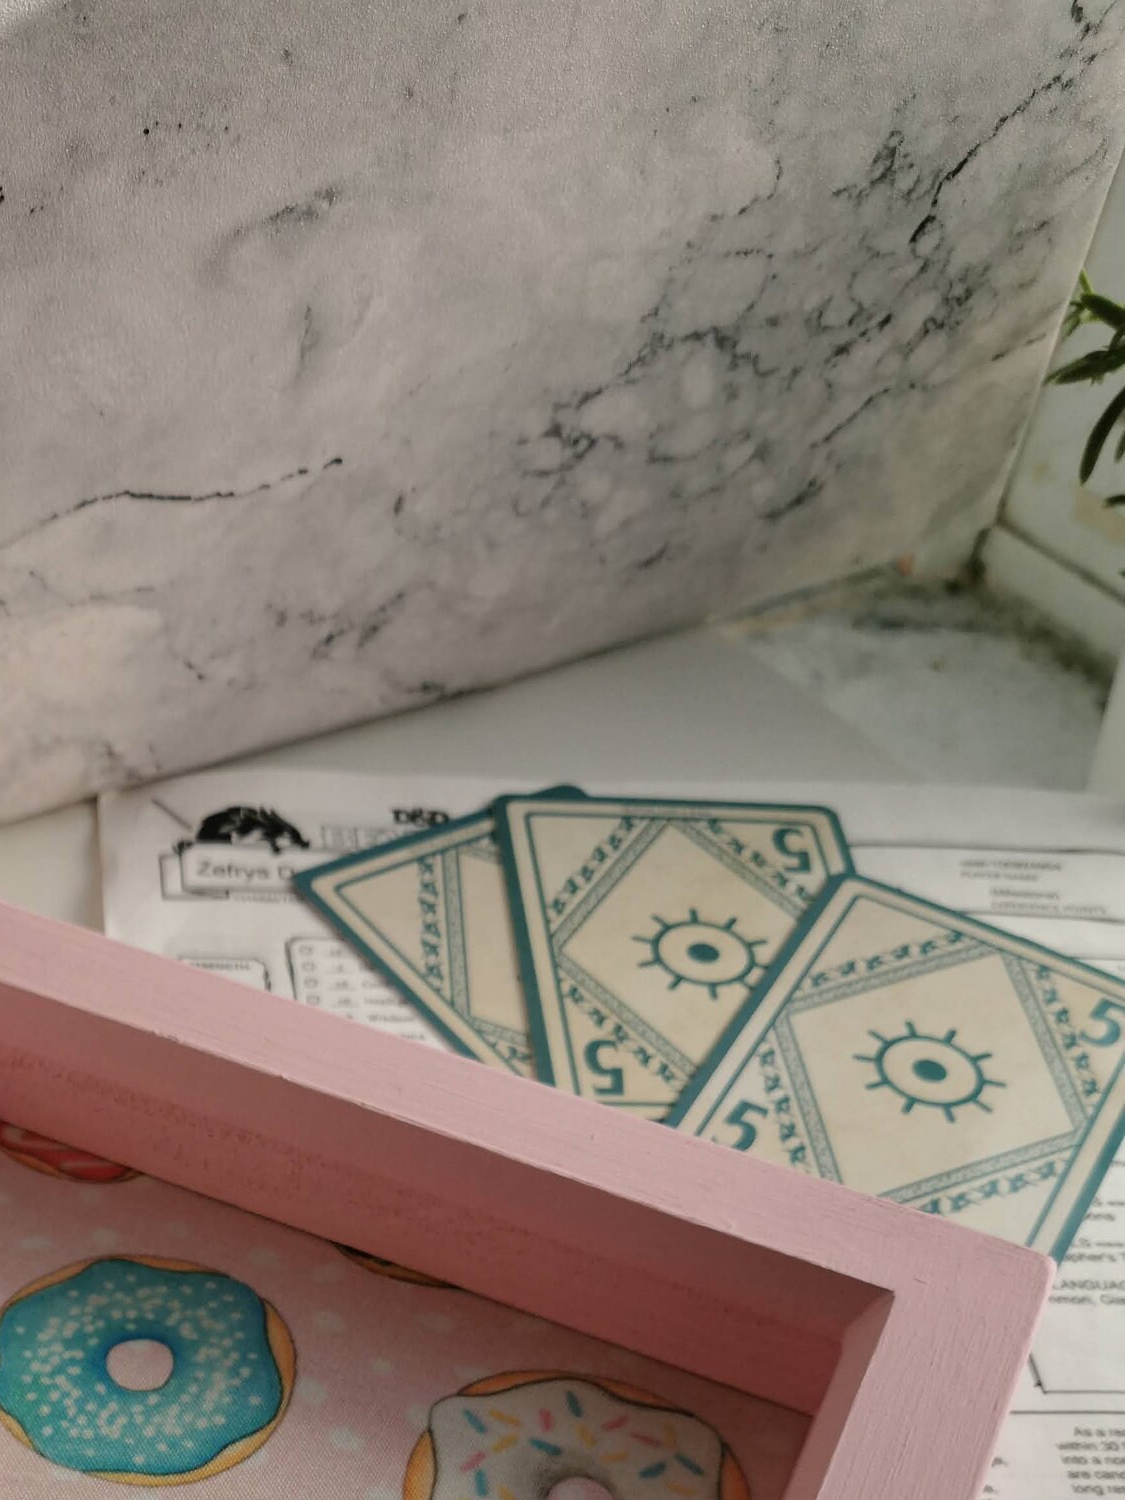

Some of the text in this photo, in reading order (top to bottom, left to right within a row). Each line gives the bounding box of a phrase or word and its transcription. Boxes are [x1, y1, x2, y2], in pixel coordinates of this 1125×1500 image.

[392, 808, 450, 828] D&D
[197, 861, 271, 883] Zefrys
[772, 828, 812, 875] 5
[1079, 998, 1125, 1047] 5
[583, 1040, 625, 1095] 5
[722, 1101, 769, 1150] 5
